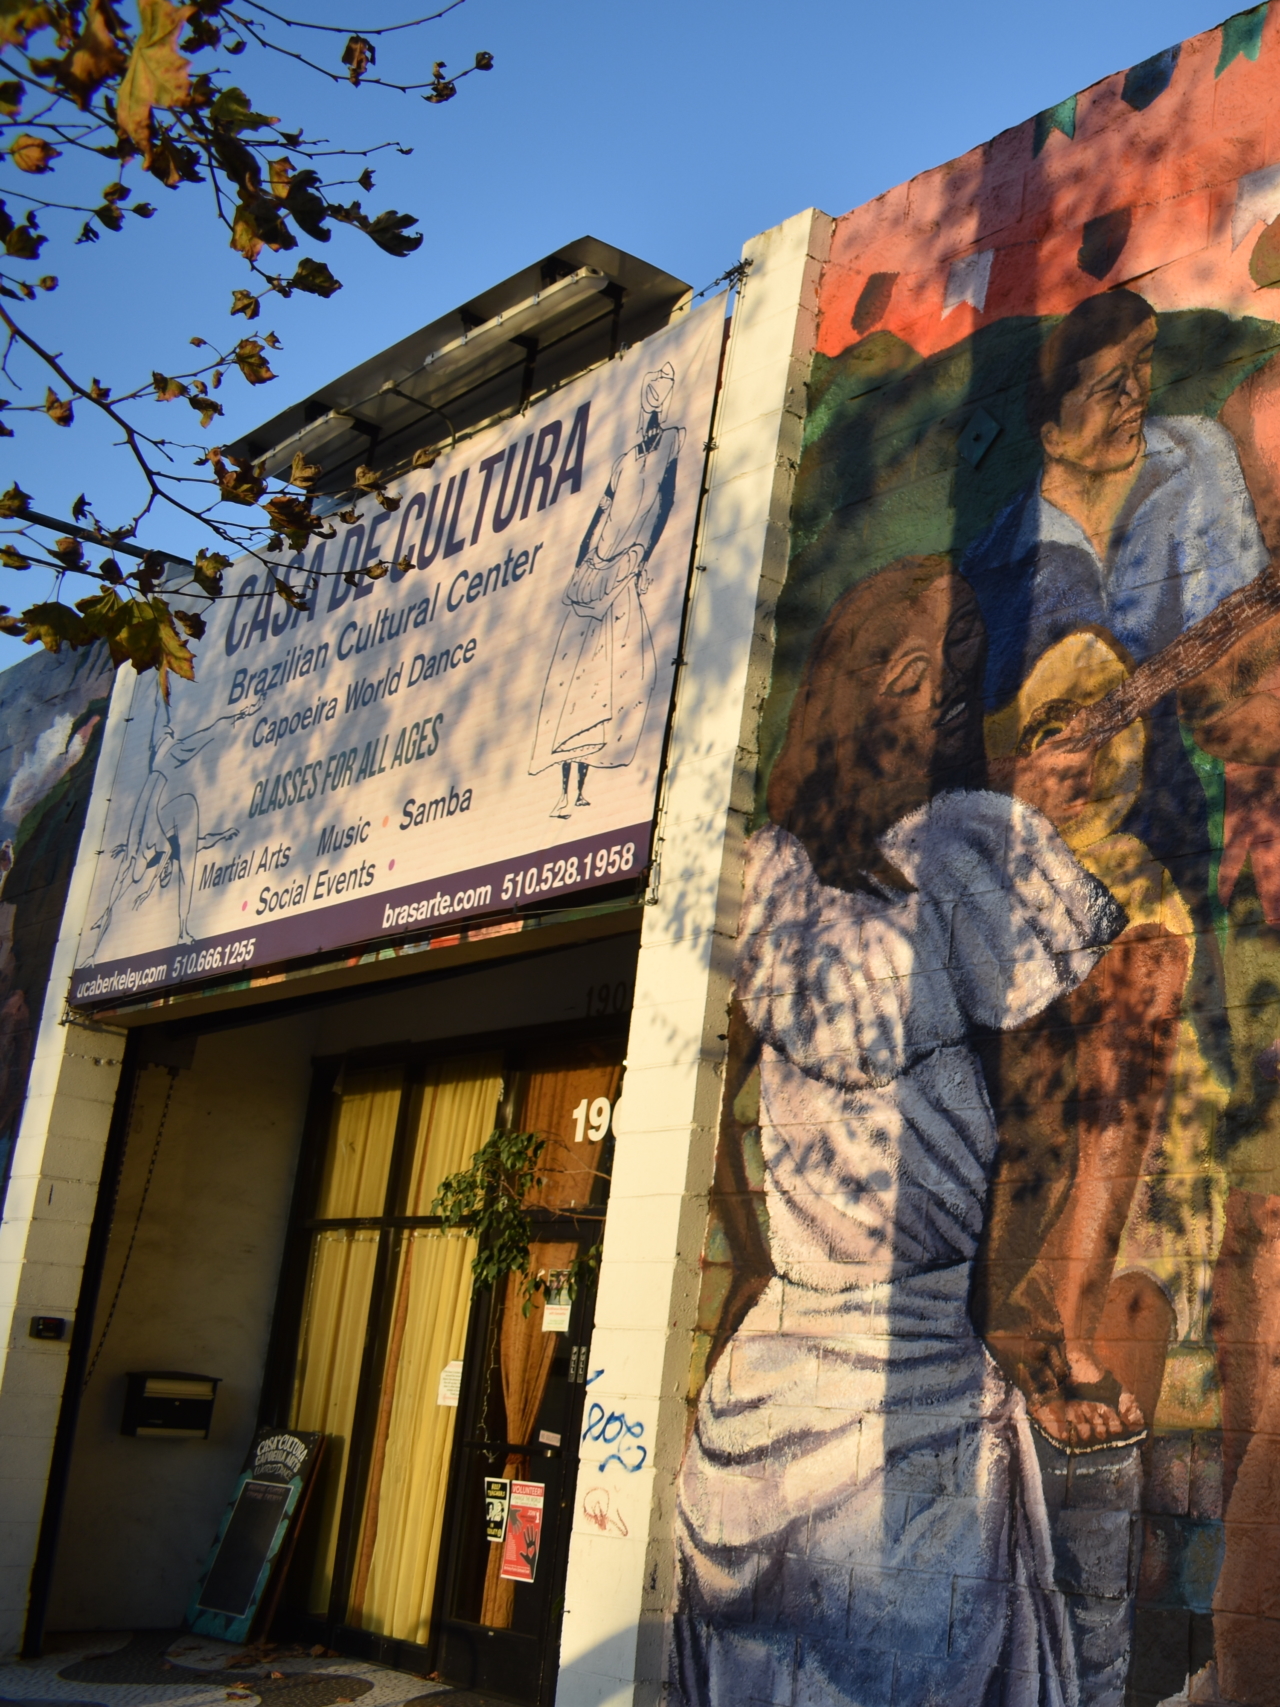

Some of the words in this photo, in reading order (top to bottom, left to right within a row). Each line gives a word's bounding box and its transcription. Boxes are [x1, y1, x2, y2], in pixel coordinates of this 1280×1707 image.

[225, 541, 328, 657] CASA
[327, 511, 391, 614] DE
[390, 401, 591, 583] CULTURA
[228, 641, 329, 706] Brazilian
[337, 582, 441, 661] Cultural
[446, 542, 544, 613] Center
[252, 696, 338, 748] Capoeira
[344, 661, 404, 713] World
[406, 638, 477, 688] Dance
[248, 760, 322, 819] CLASSES
[321, 747, 359, 795] FOR
[355, 734, 389, 783] ALL
[390, 712, 444, 770] AGES
[199, 850, 255, 891] Martial
[255, 842, 291, 875] Arts
[316, 816, 371, 857] Music
[399, 786, 473, 830] Samba
[255, 875, 311, 916] Social
[313, 859, 376, 900] Events
[382, 884, 492, 928] brasarte.com
[501, 842, 635, 900] 510.528.1958
[76, 964, 167, 998] ucaberkeley.com
[172, 938, 256, 978] 510.666.1255
